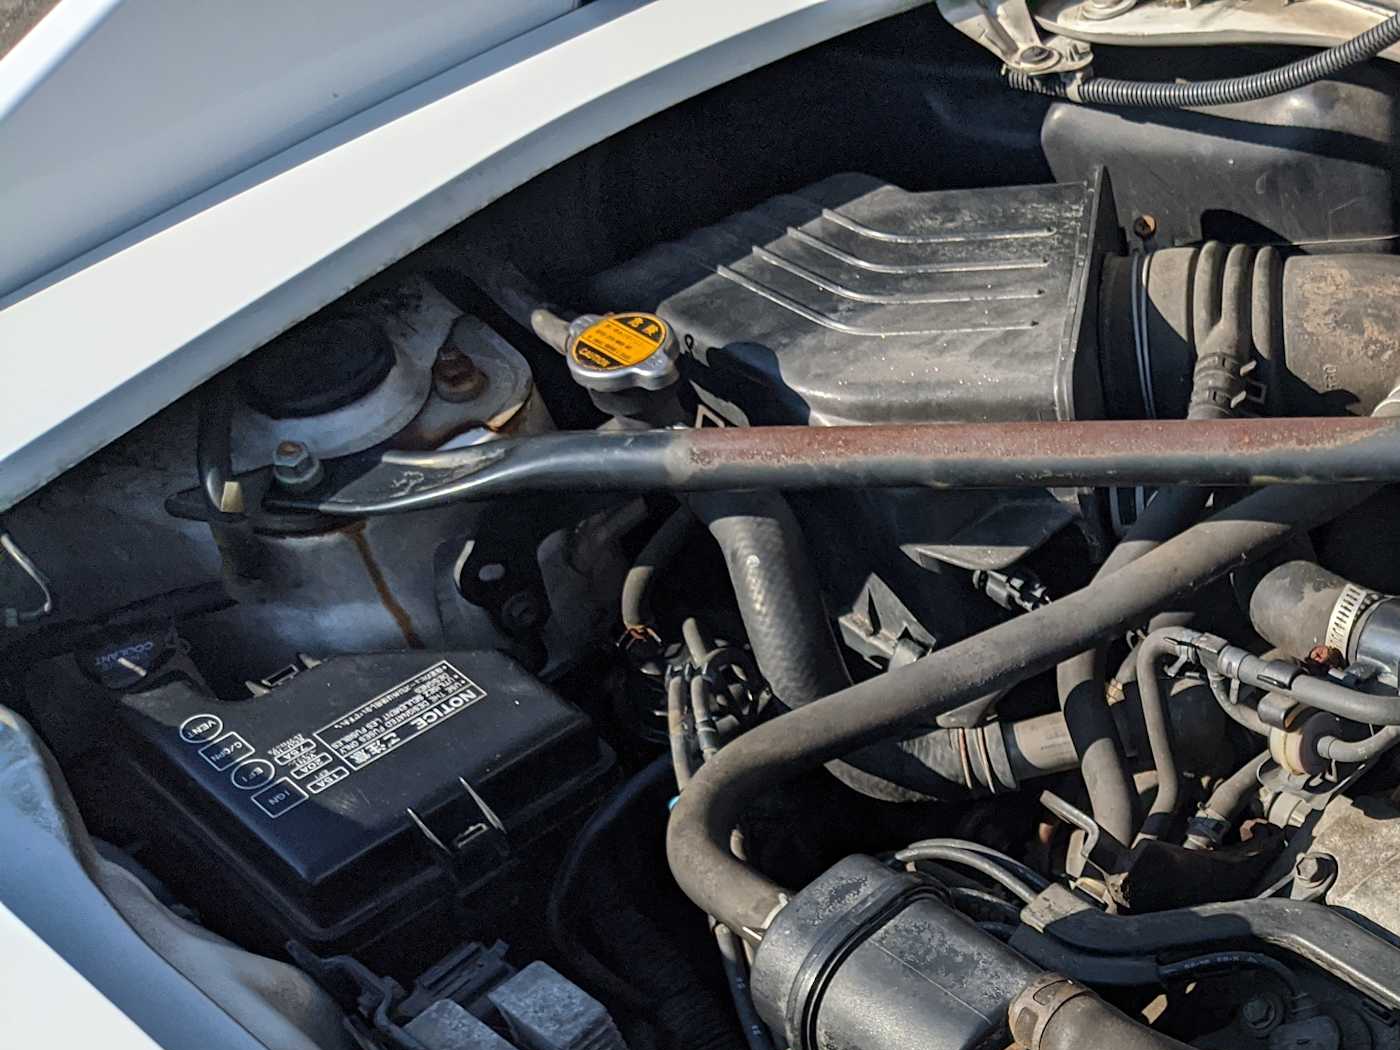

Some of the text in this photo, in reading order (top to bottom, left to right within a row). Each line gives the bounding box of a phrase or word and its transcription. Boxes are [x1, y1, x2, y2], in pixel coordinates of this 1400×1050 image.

[410, 688, 477, 731] NOTICE
[185, 719, 217, 739] VENT
[359, 725, 385, 742] FUSES
[350, 731, 401, 766] ご注意
[299, 758, 322, 773] 20A
[316, 773, 339, 788] 15A
[268, 790, 291, 805] IGN
